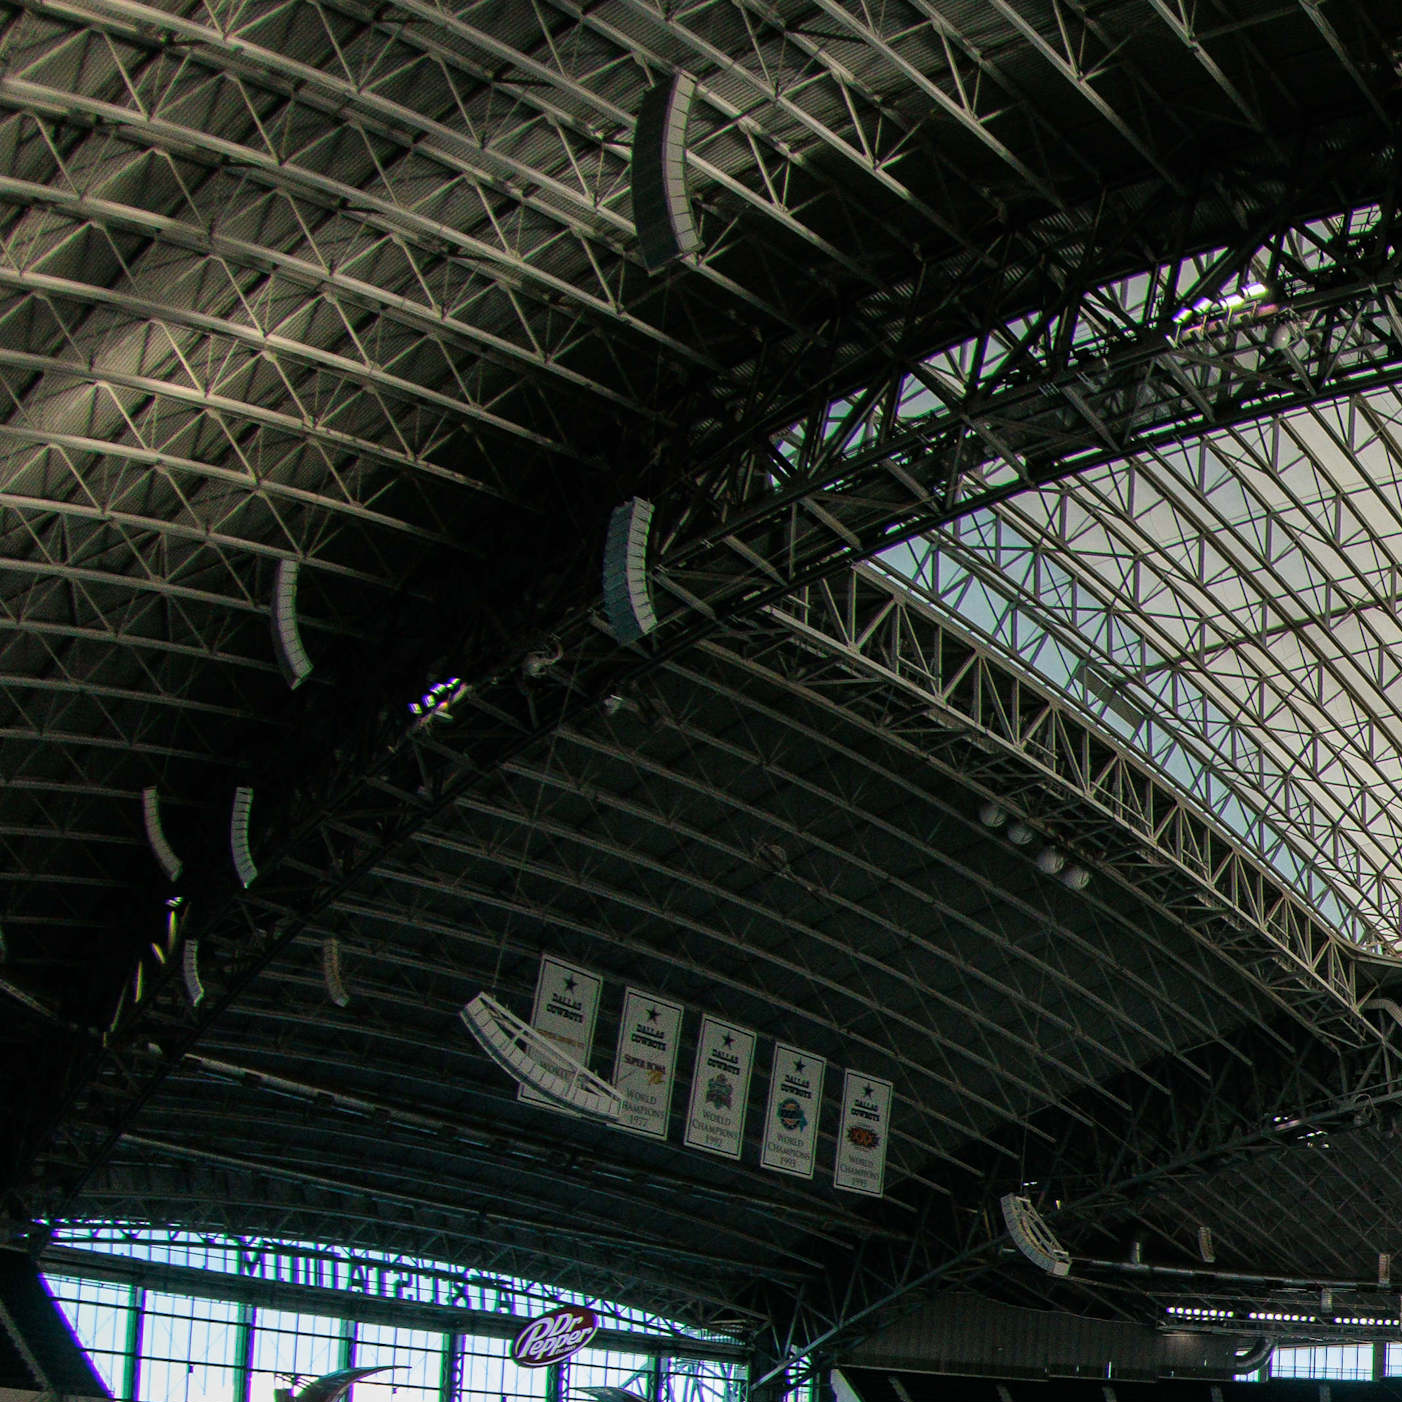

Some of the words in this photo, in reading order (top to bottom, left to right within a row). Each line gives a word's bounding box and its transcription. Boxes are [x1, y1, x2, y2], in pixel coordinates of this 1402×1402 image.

[552, 993, 582, 1011] DALLAS
[546, 1003, 584, 1023] COWBOYS
[637, 1024, 664, 1040] DALLAS
[631, 1035, 666, 1051] COWBOYS
[711, 1048, 739, 1064] DALLAS
[707, 1057, 740, 1075] COWBOYS
[784, 1074, 810, 1089] DALLAS
[626, 1088, 656, 1105] WORLD
[780, 1084, 812, 1099] COWBOYS
[854, 1099, 878, 1111] DALLAS
[702, 1110, 731, 1126] WORLD
[850, 1108, 880, 1122] COWBOYS
[692, 1119, 737, 1140] CHAMPIONS
[778, 1133, 804, 1147] WORLD
[768, 1142, 810, 1160] CHAMPIONS
[848, 1153, 873, 1167] WORLD
[840, 1164, 879, 1180] CHAMPIONS
[549, 1313, 584, 1337] Dr
[515, 1317, 593, 1361] Pepper
